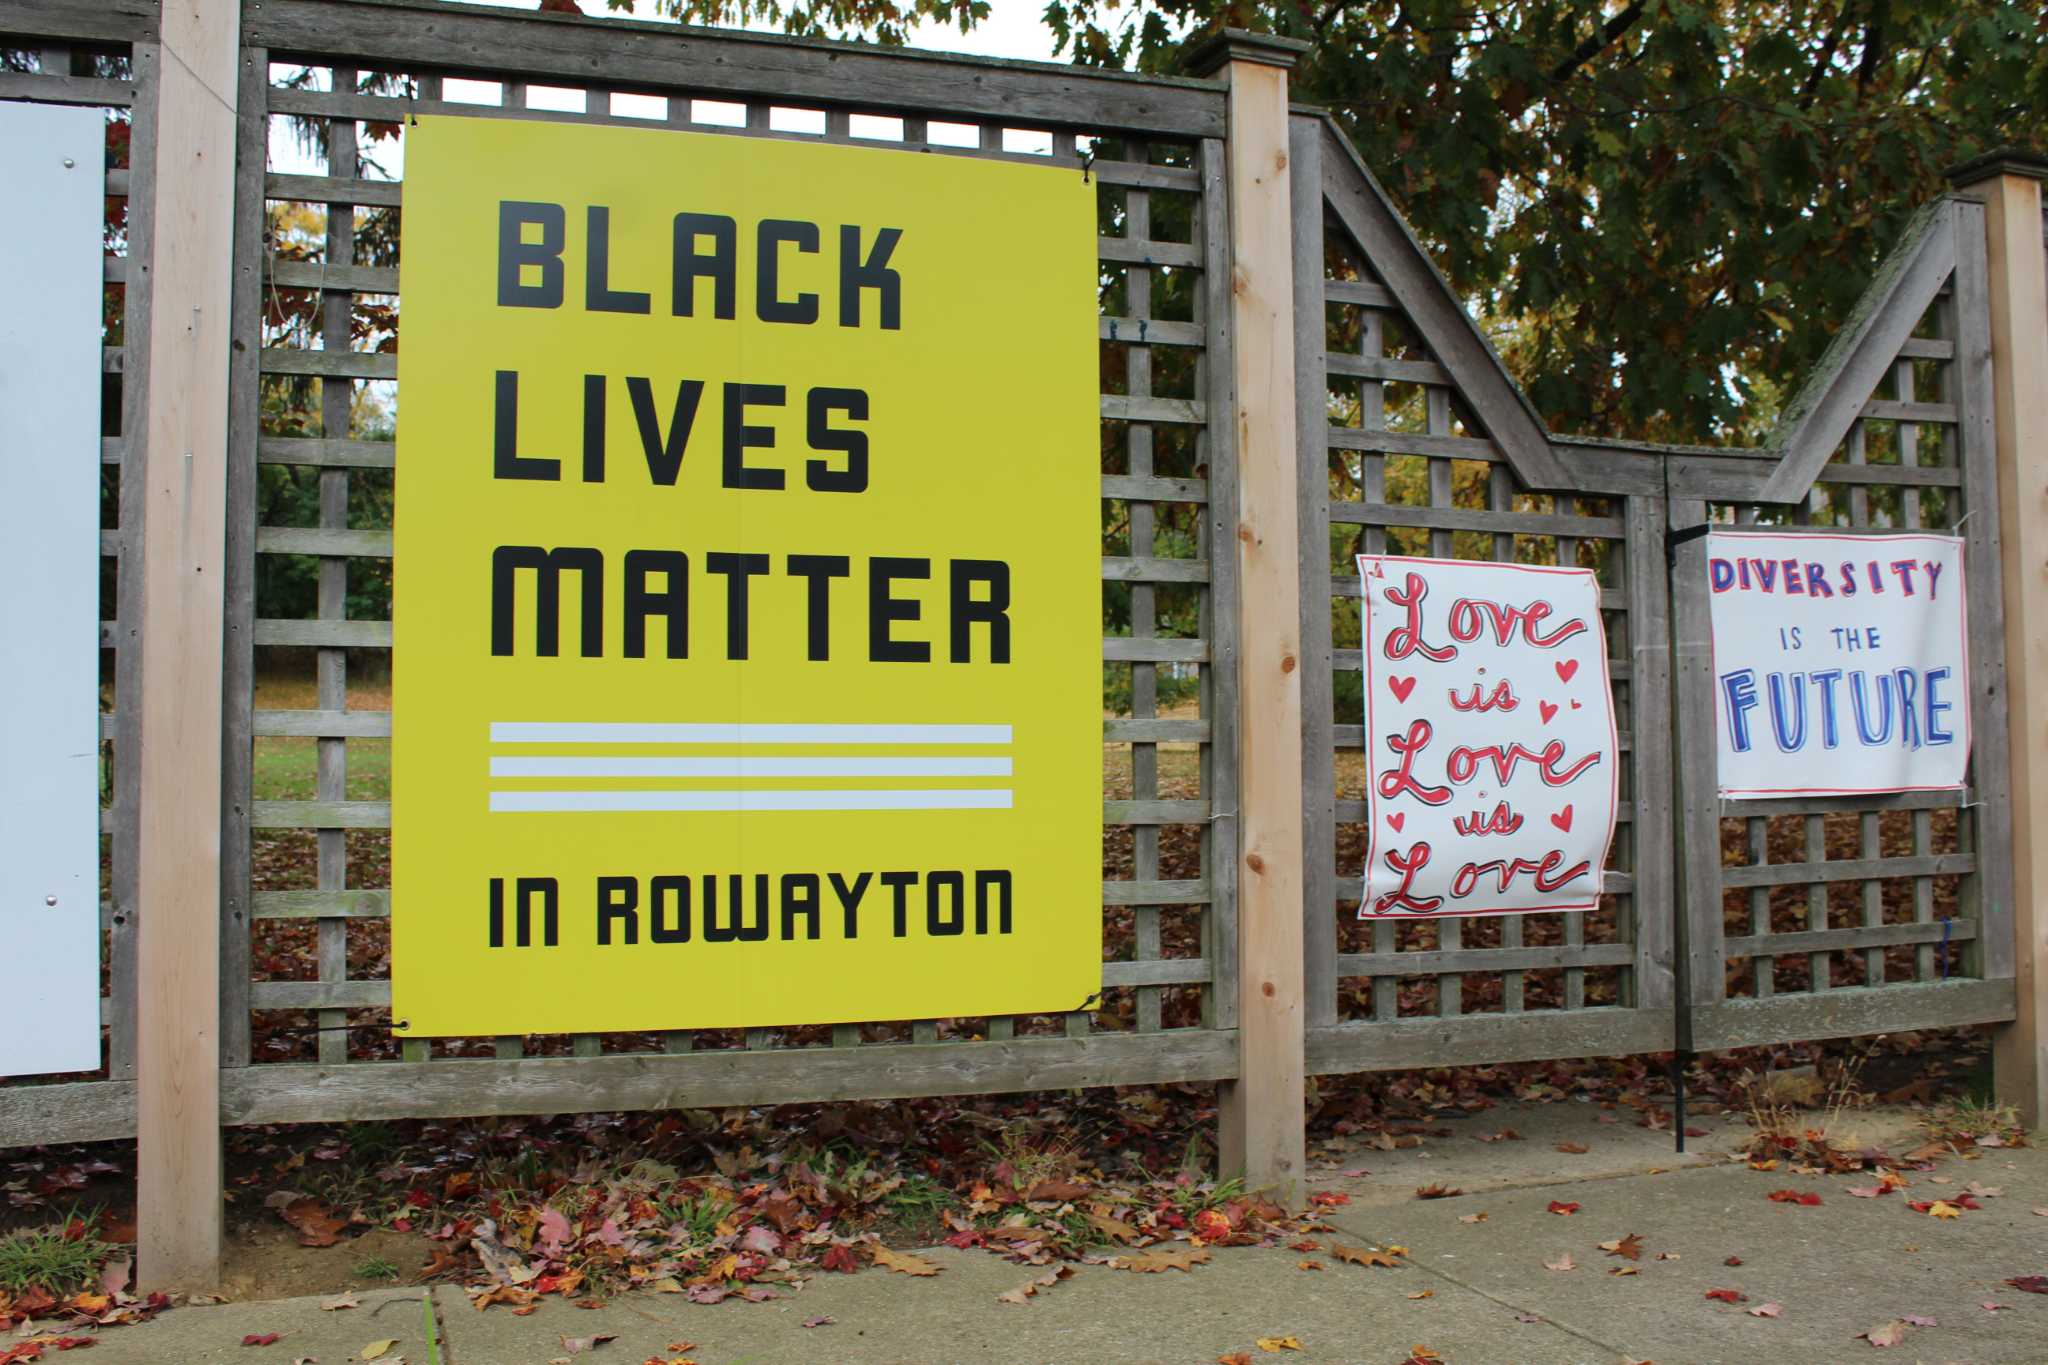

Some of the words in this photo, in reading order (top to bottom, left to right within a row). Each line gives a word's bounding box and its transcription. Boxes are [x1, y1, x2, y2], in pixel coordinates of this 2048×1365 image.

[497, 201, 903, 330] BLACK
[494, 370, 869, 493] LIVES
[491, 546, 1010, 664] MATTER
[1384, 572, 1587, 662] Love
[1710, 557, 1943, 600] DIVERSITY
[1780, 627, 1802, 651] IS
[1831, 626, 1881, 650] THE
[1448, 667, 1518, 712] is
[1721, 666, 1953, 753] FUTURE
[1379, 719, 1600, 805] Love
[1454, 791, 1523, 836] is
[489, 877, 558, 947] IN
[597, 870, 1012, 945] ROWAYTON
[1376, 842, 1591, 913] Love
